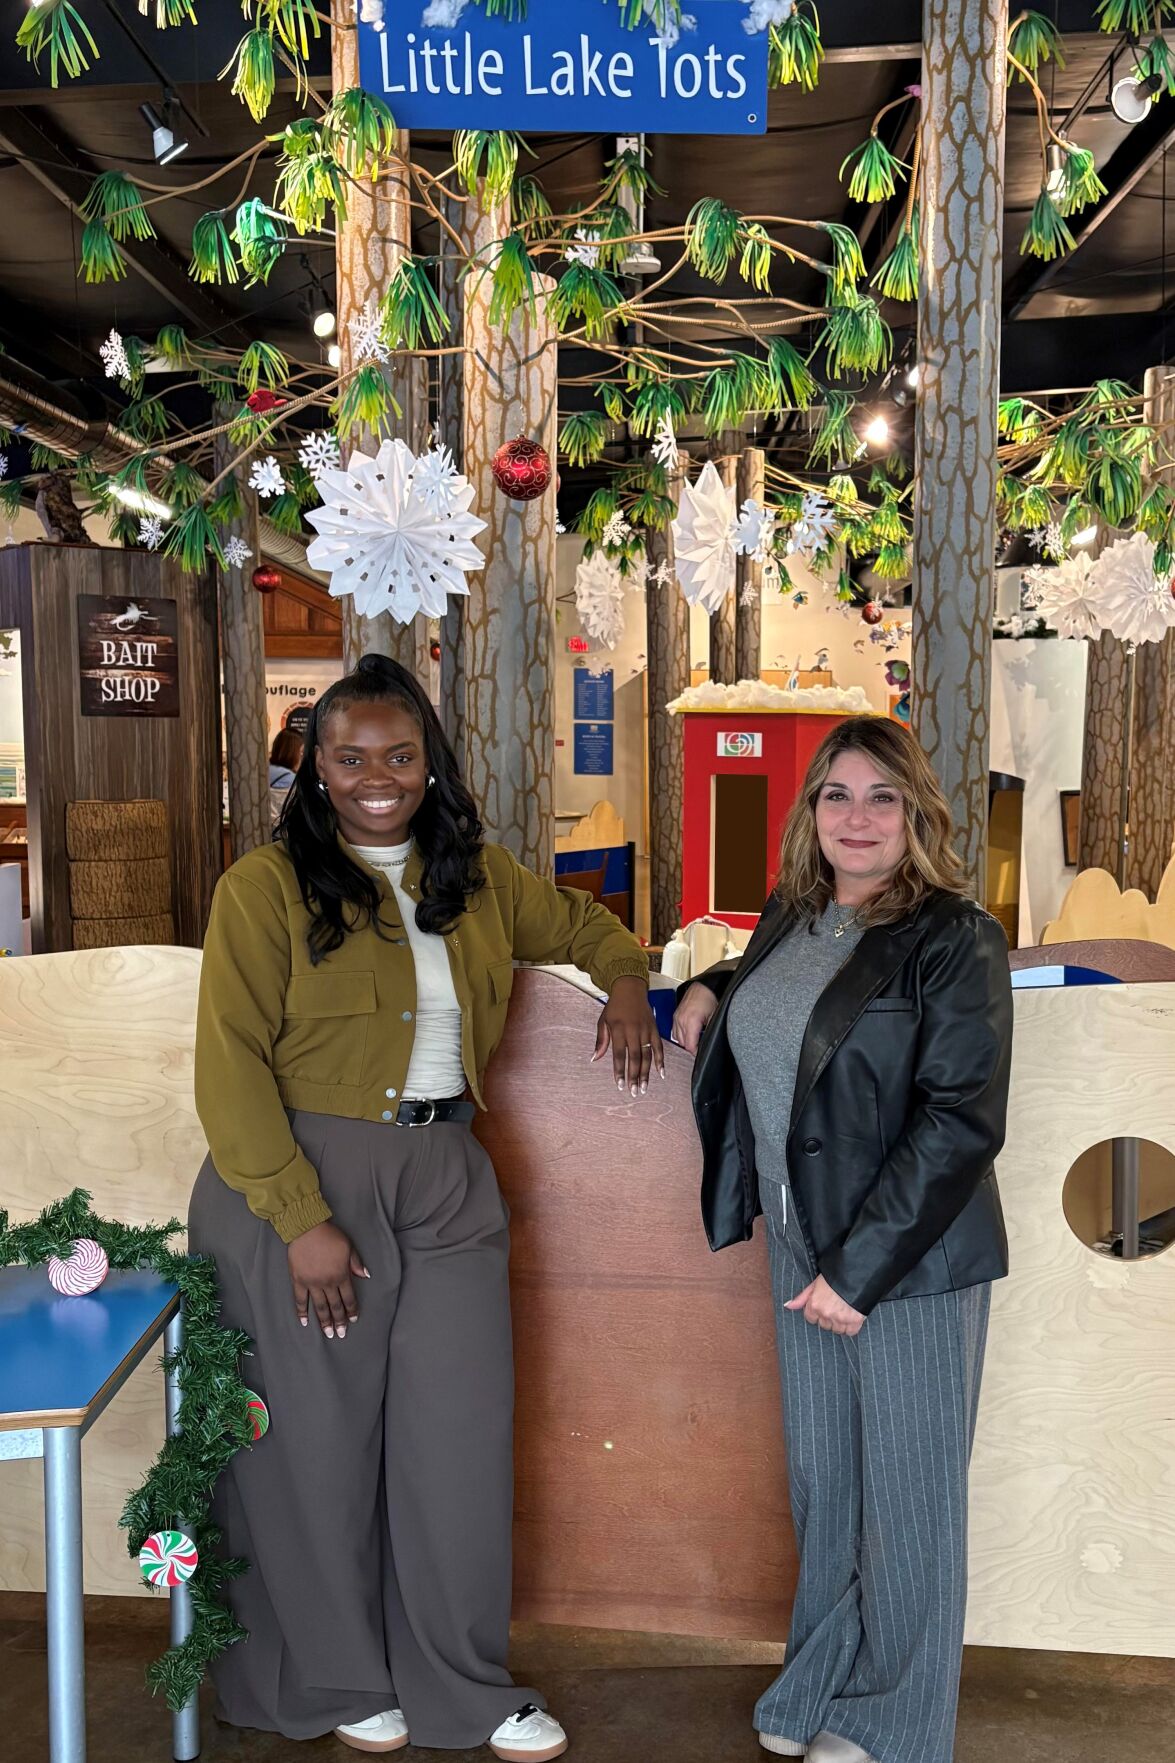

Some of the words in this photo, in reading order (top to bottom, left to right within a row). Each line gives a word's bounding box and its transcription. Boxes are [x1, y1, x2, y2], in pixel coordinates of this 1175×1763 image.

[379, 31, 504, 96] Little
[523, 33, 634, 98] Lake
[648, 37, 747, 99] Tots
[100, 640, 158, 667] BAIT
[101, 676, 160, 703] SHOP
